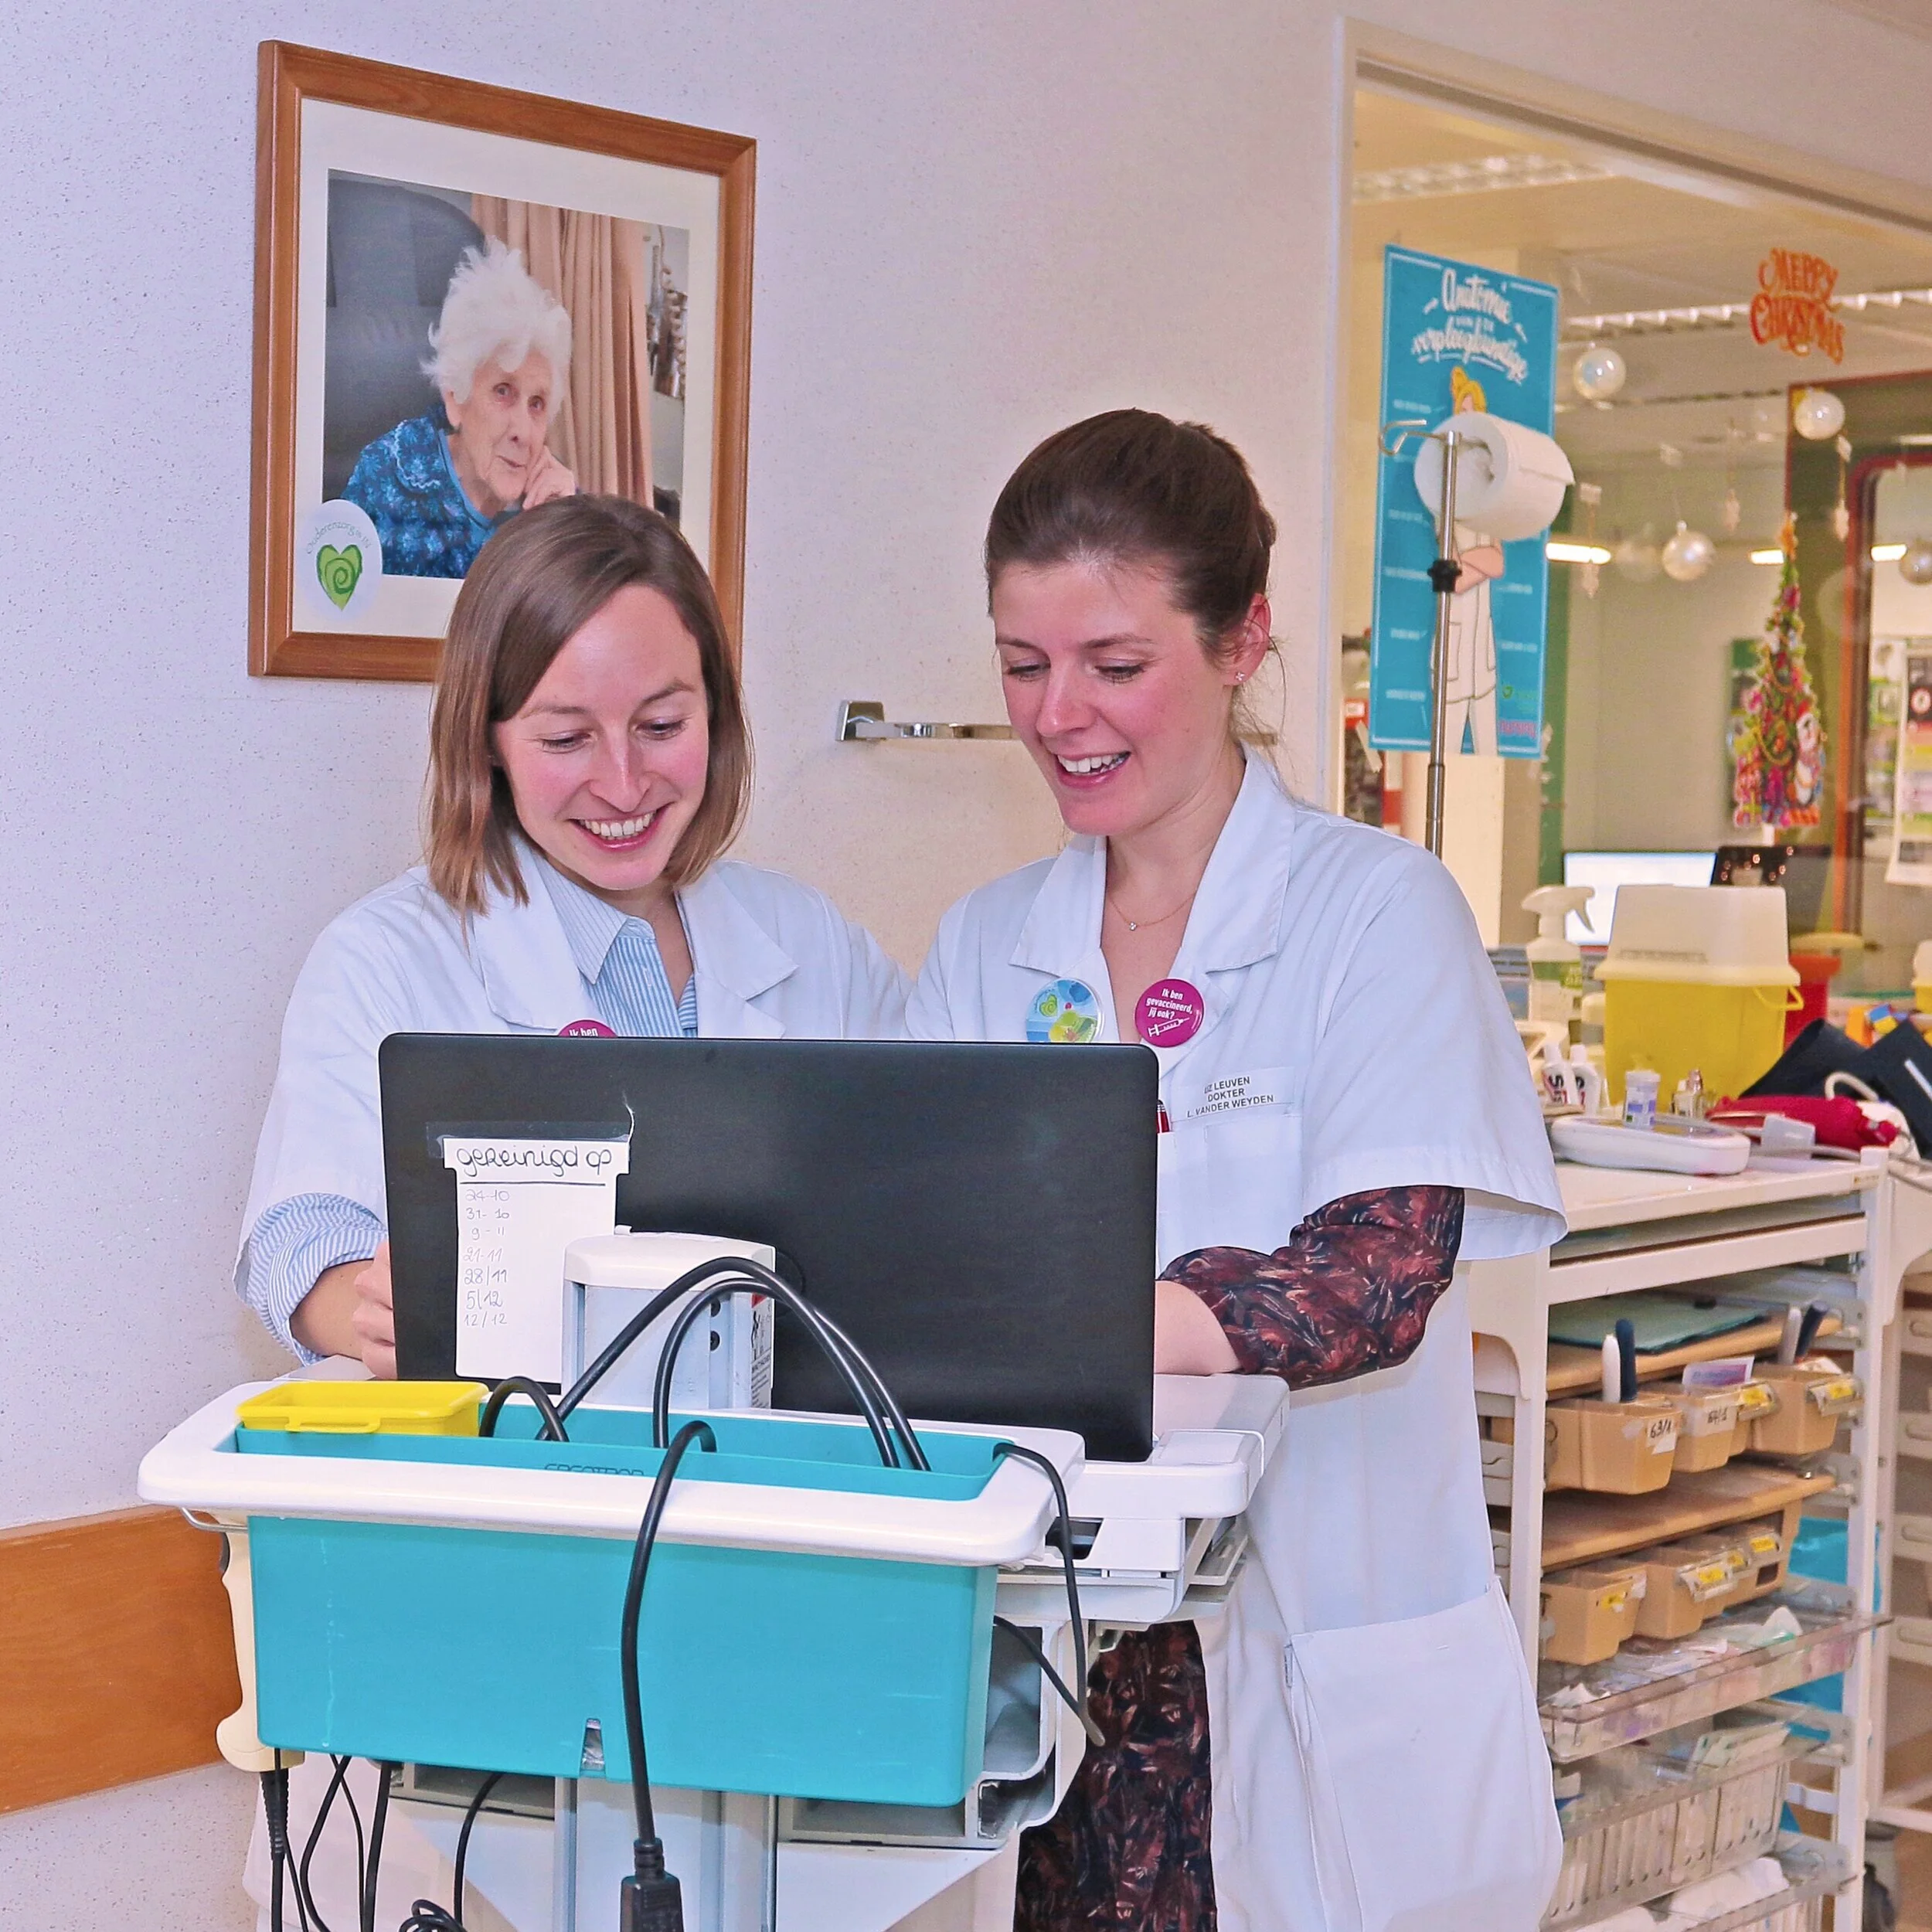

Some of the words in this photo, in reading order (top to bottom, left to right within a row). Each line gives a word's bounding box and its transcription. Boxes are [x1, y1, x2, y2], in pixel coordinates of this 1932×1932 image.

[1162, 988, 1170, 998] Ik
[1169, 989, 1184, 1000] ben
[1145, 998, 1193, 1015] gevaccineerd,
[1157, 1009, 1175, 1020] ook?
[1213, 1076, 1250, 1090] LEUVEN
[1207, 1087, 1245, 1103] DOKTER
[1196, 1101, 1230, 1116] VANDER
[1231, 1094, 1274, 1108] WEYDEN
[586, 1148, 612, 1175] op
